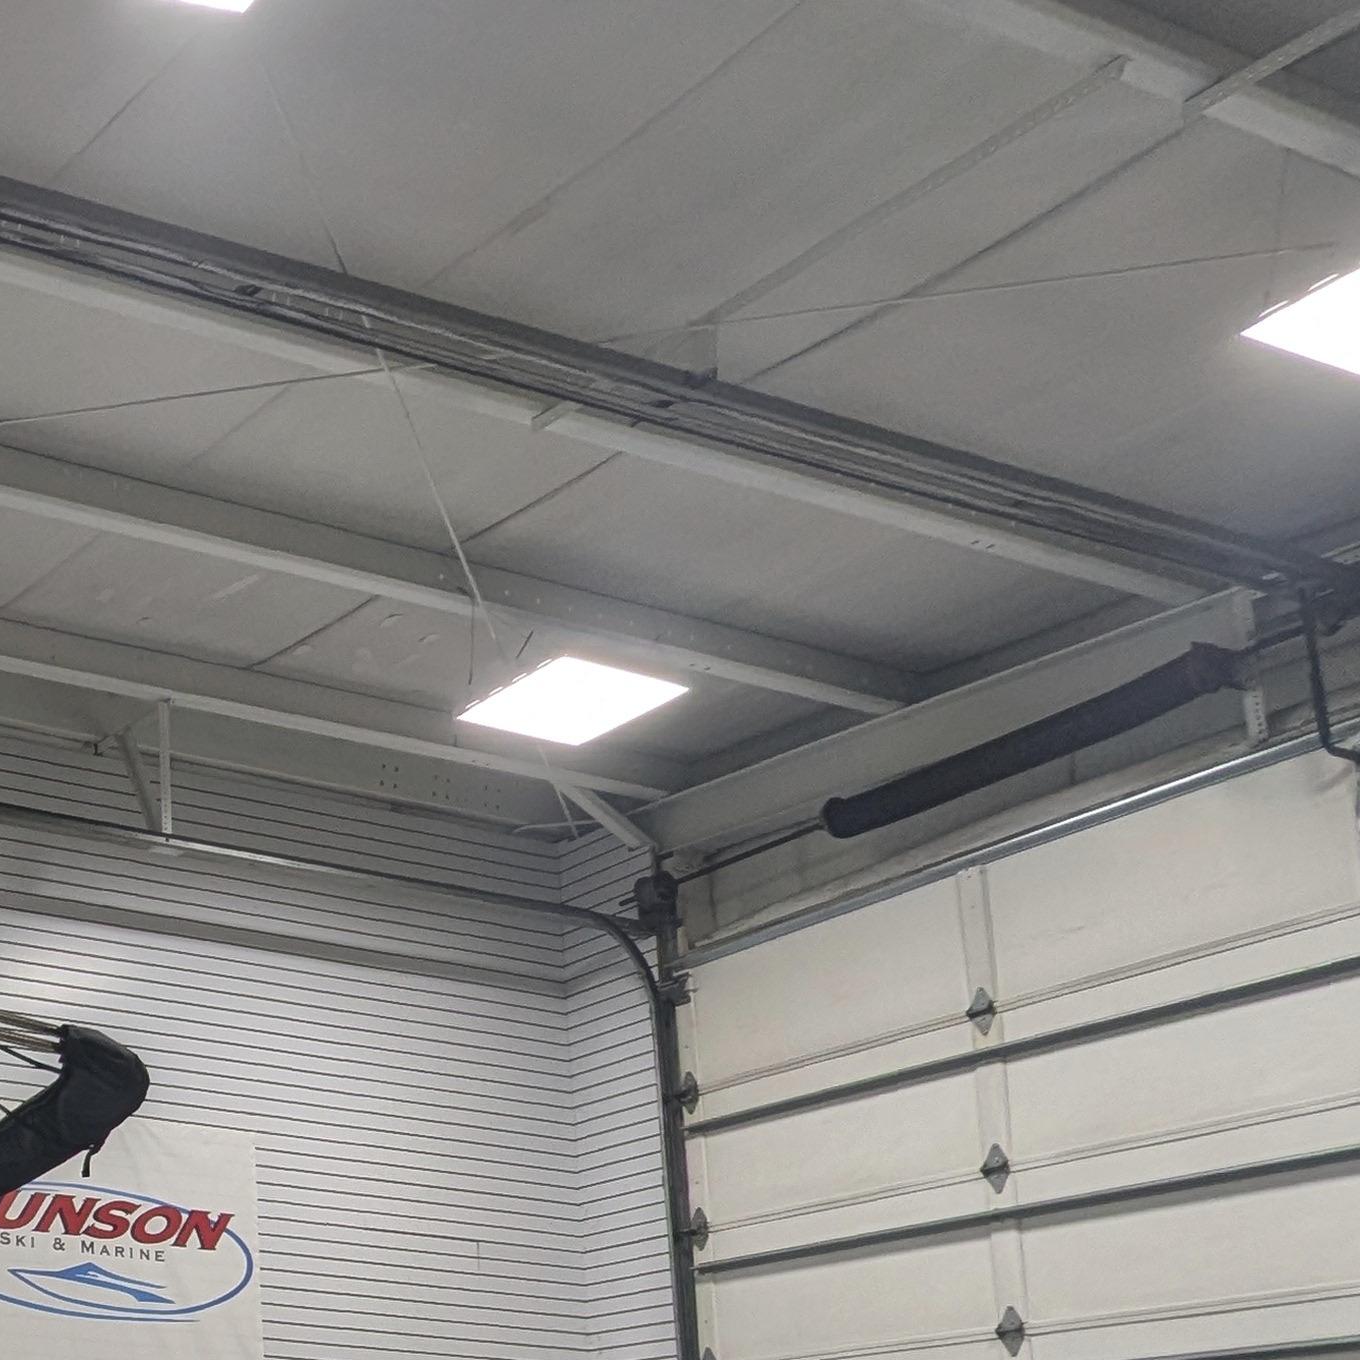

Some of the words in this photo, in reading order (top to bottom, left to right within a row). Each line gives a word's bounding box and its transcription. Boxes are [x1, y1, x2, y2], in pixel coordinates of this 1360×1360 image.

[0, 1232, 35, 1249] SKI
[52, 1238, 66, 1252] &
[80, 1241, 166, 1263] MARINE
